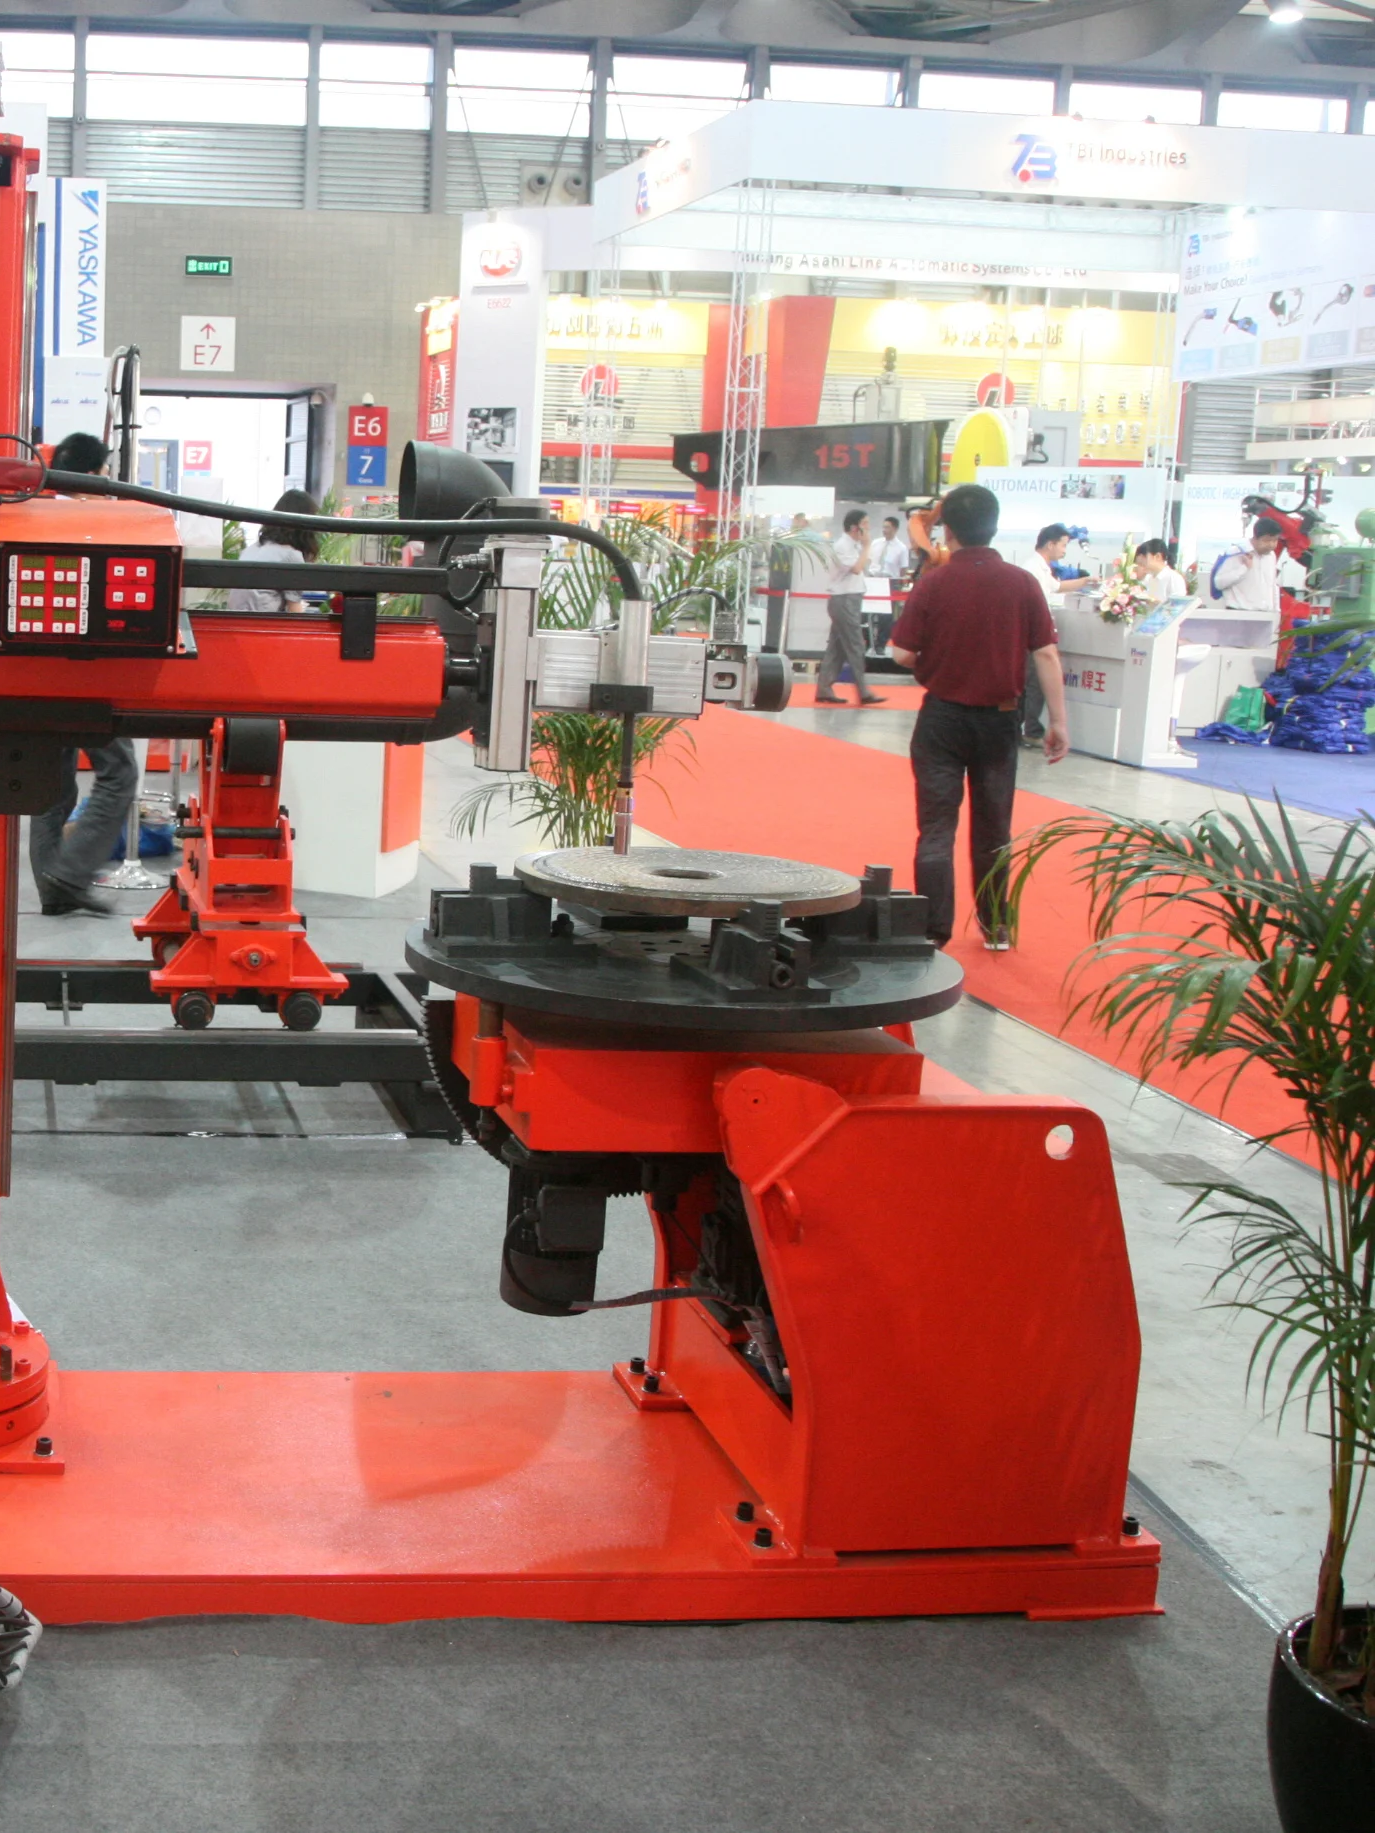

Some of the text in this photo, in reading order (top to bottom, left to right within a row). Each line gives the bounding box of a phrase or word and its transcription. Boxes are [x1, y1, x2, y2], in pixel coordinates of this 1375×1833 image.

[198, 262, 219, 271] EXIT
[799, 254, 844, 269] Asahi
[849, 257, 883, 270] Line
[77, 223, 99, 346] YASKAWA
[1184, 282, 1202, 296] Make
[1204, 280, 1219, 291] Your
[194, 345, 222, 365] E7
[354, 416, 381, 436] E6
[186, 447, 208, 464] E7
[814, 444, 876, 469] 15T
[359, 455, 374, 475] 7
[983, 478, 1058, 493] AUTOMATIC
